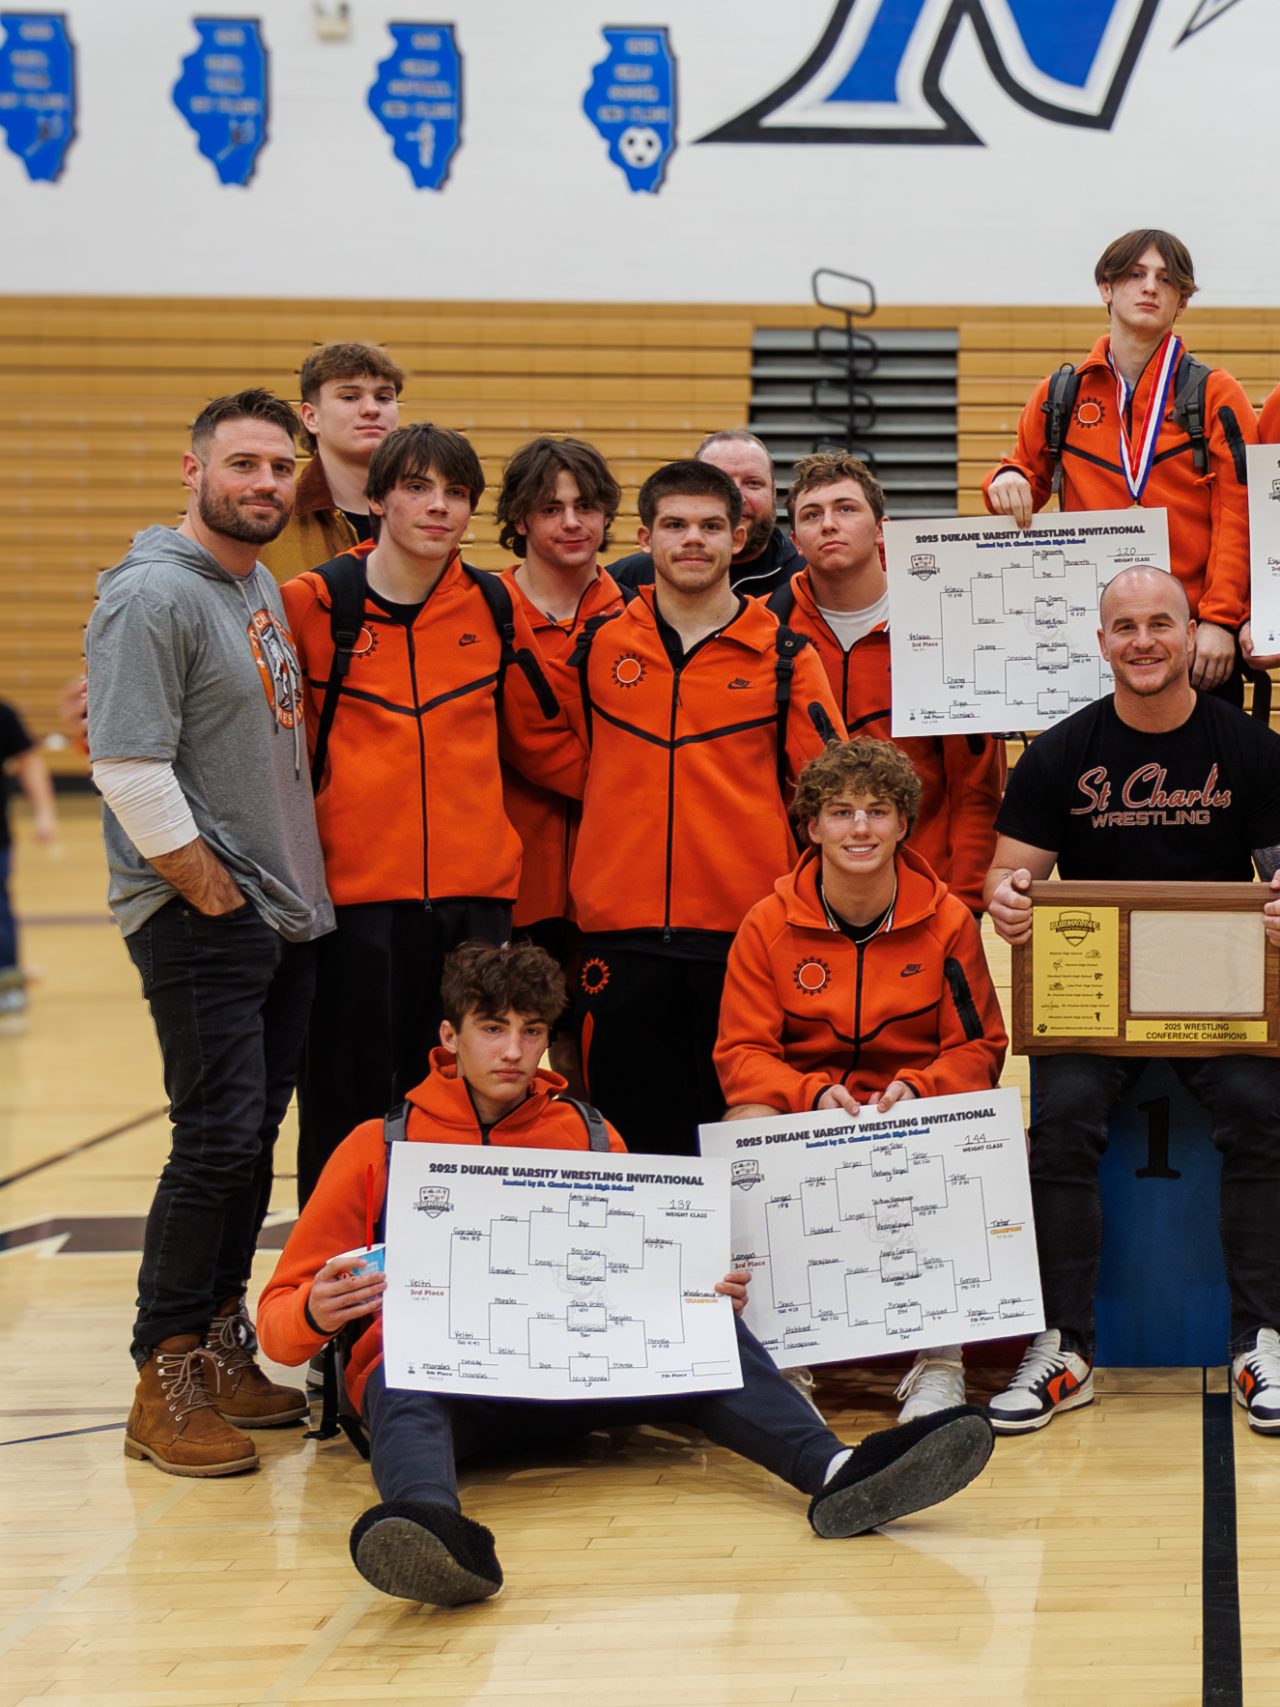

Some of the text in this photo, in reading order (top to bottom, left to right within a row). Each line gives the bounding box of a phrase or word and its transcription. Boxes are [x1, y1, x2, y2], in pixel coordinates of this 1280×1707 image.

[916, 526, 1145, 543] 2025 DUKANE VARSITY WRESTLING INVITATIONAL
[1070, 766, 1111, 814] St
[1092, 810, 1210, 828] WRESTLING
[1164, 1023, 1229, 1031] 2025 WRESTLING
[1146, 1032, 1247, 1040] CONFERENCE CHAMPIONS
[736, 1108, 996, 1149] 2025 DUKANE VARSITY WRESTLING INVITATIONAL
[1135, 1095, 1181, 1178] 1
[965, 1133, 986, 1144] 144
[429, 1163, 704, 1186] 2025 DUKANE VARSITY WRESTLING INVITATIONAL
[670, 1200, 691, 1210] 138
